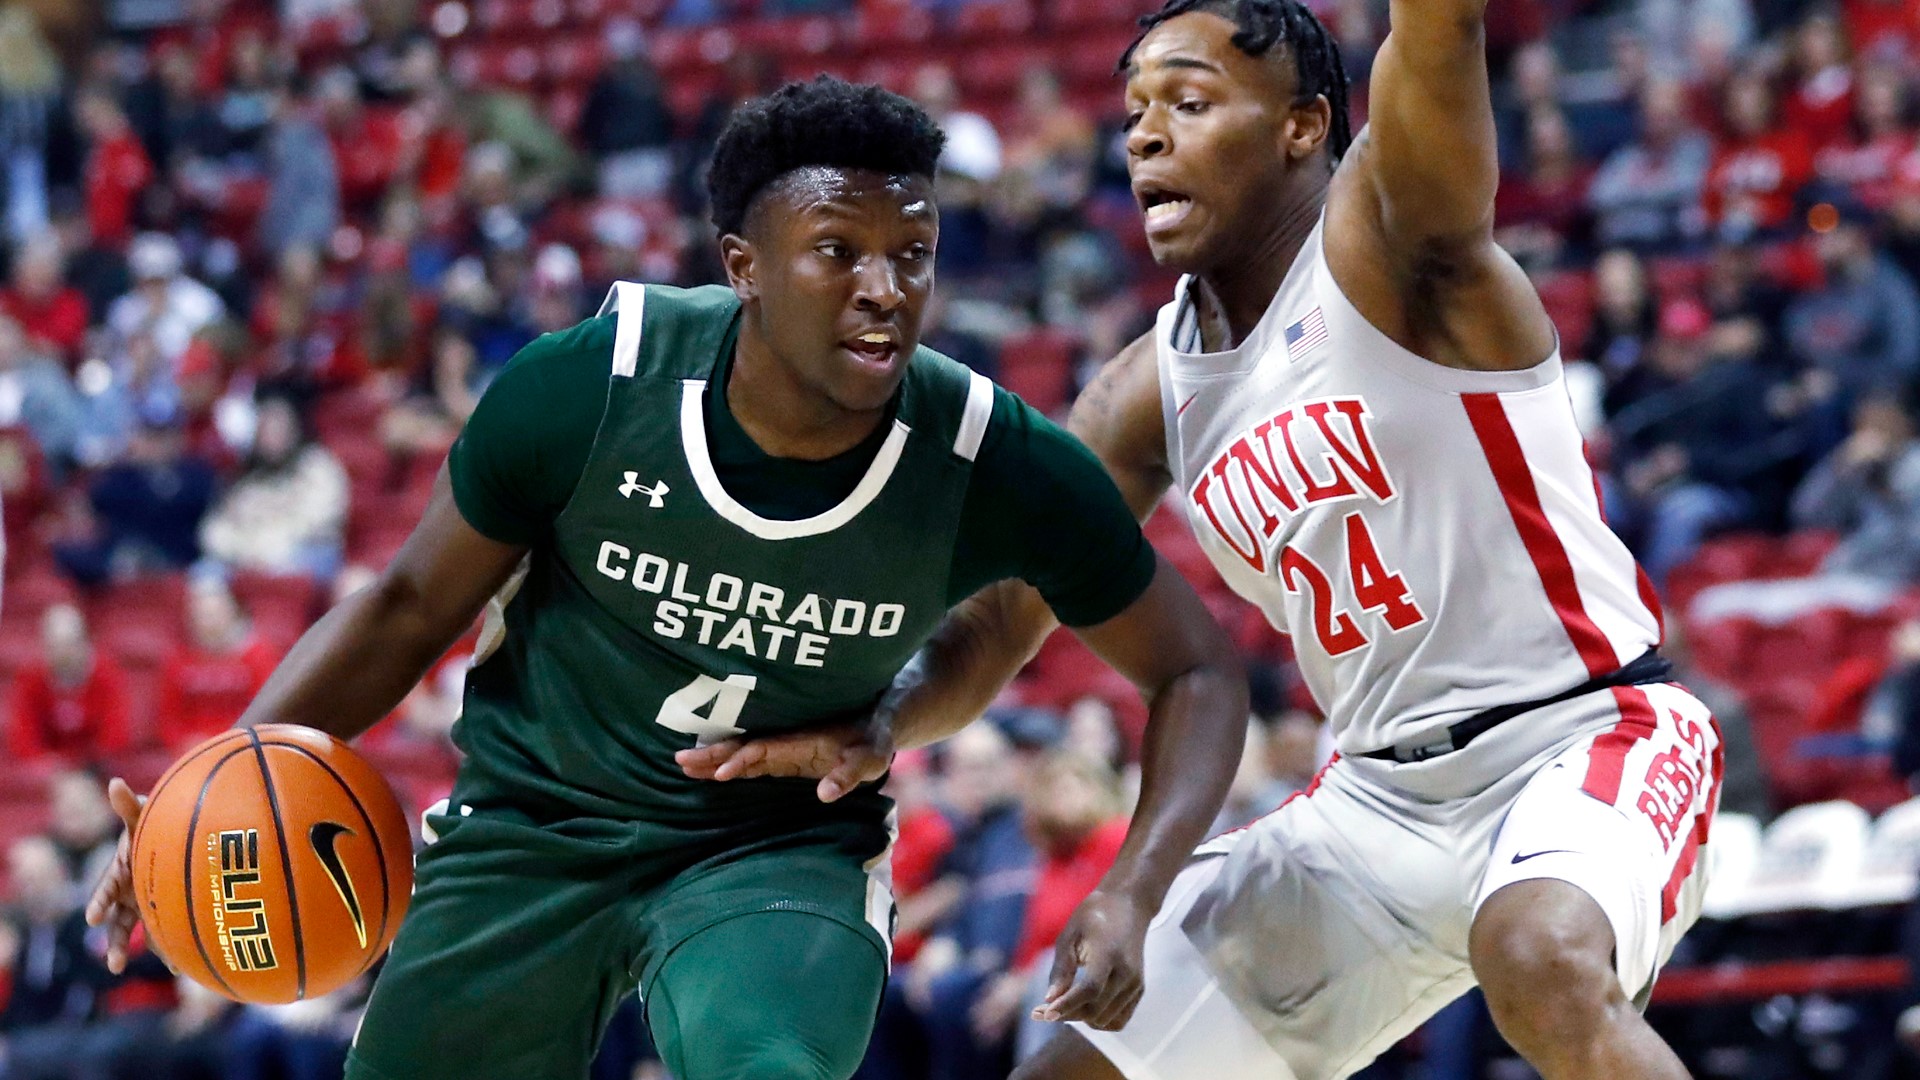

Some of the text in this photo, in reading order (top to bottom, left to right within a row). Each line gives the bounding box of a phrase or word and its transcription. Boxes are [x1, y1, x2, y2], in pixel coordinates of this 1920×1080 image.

[1189, 395, 1398, 576] UNLV
[596, 541, 906, 638] COLORADO
[1278, 510, 1428, 659] 24
[653, 601, 830, 668] STATE
[655, 674, 758, 748] 4
